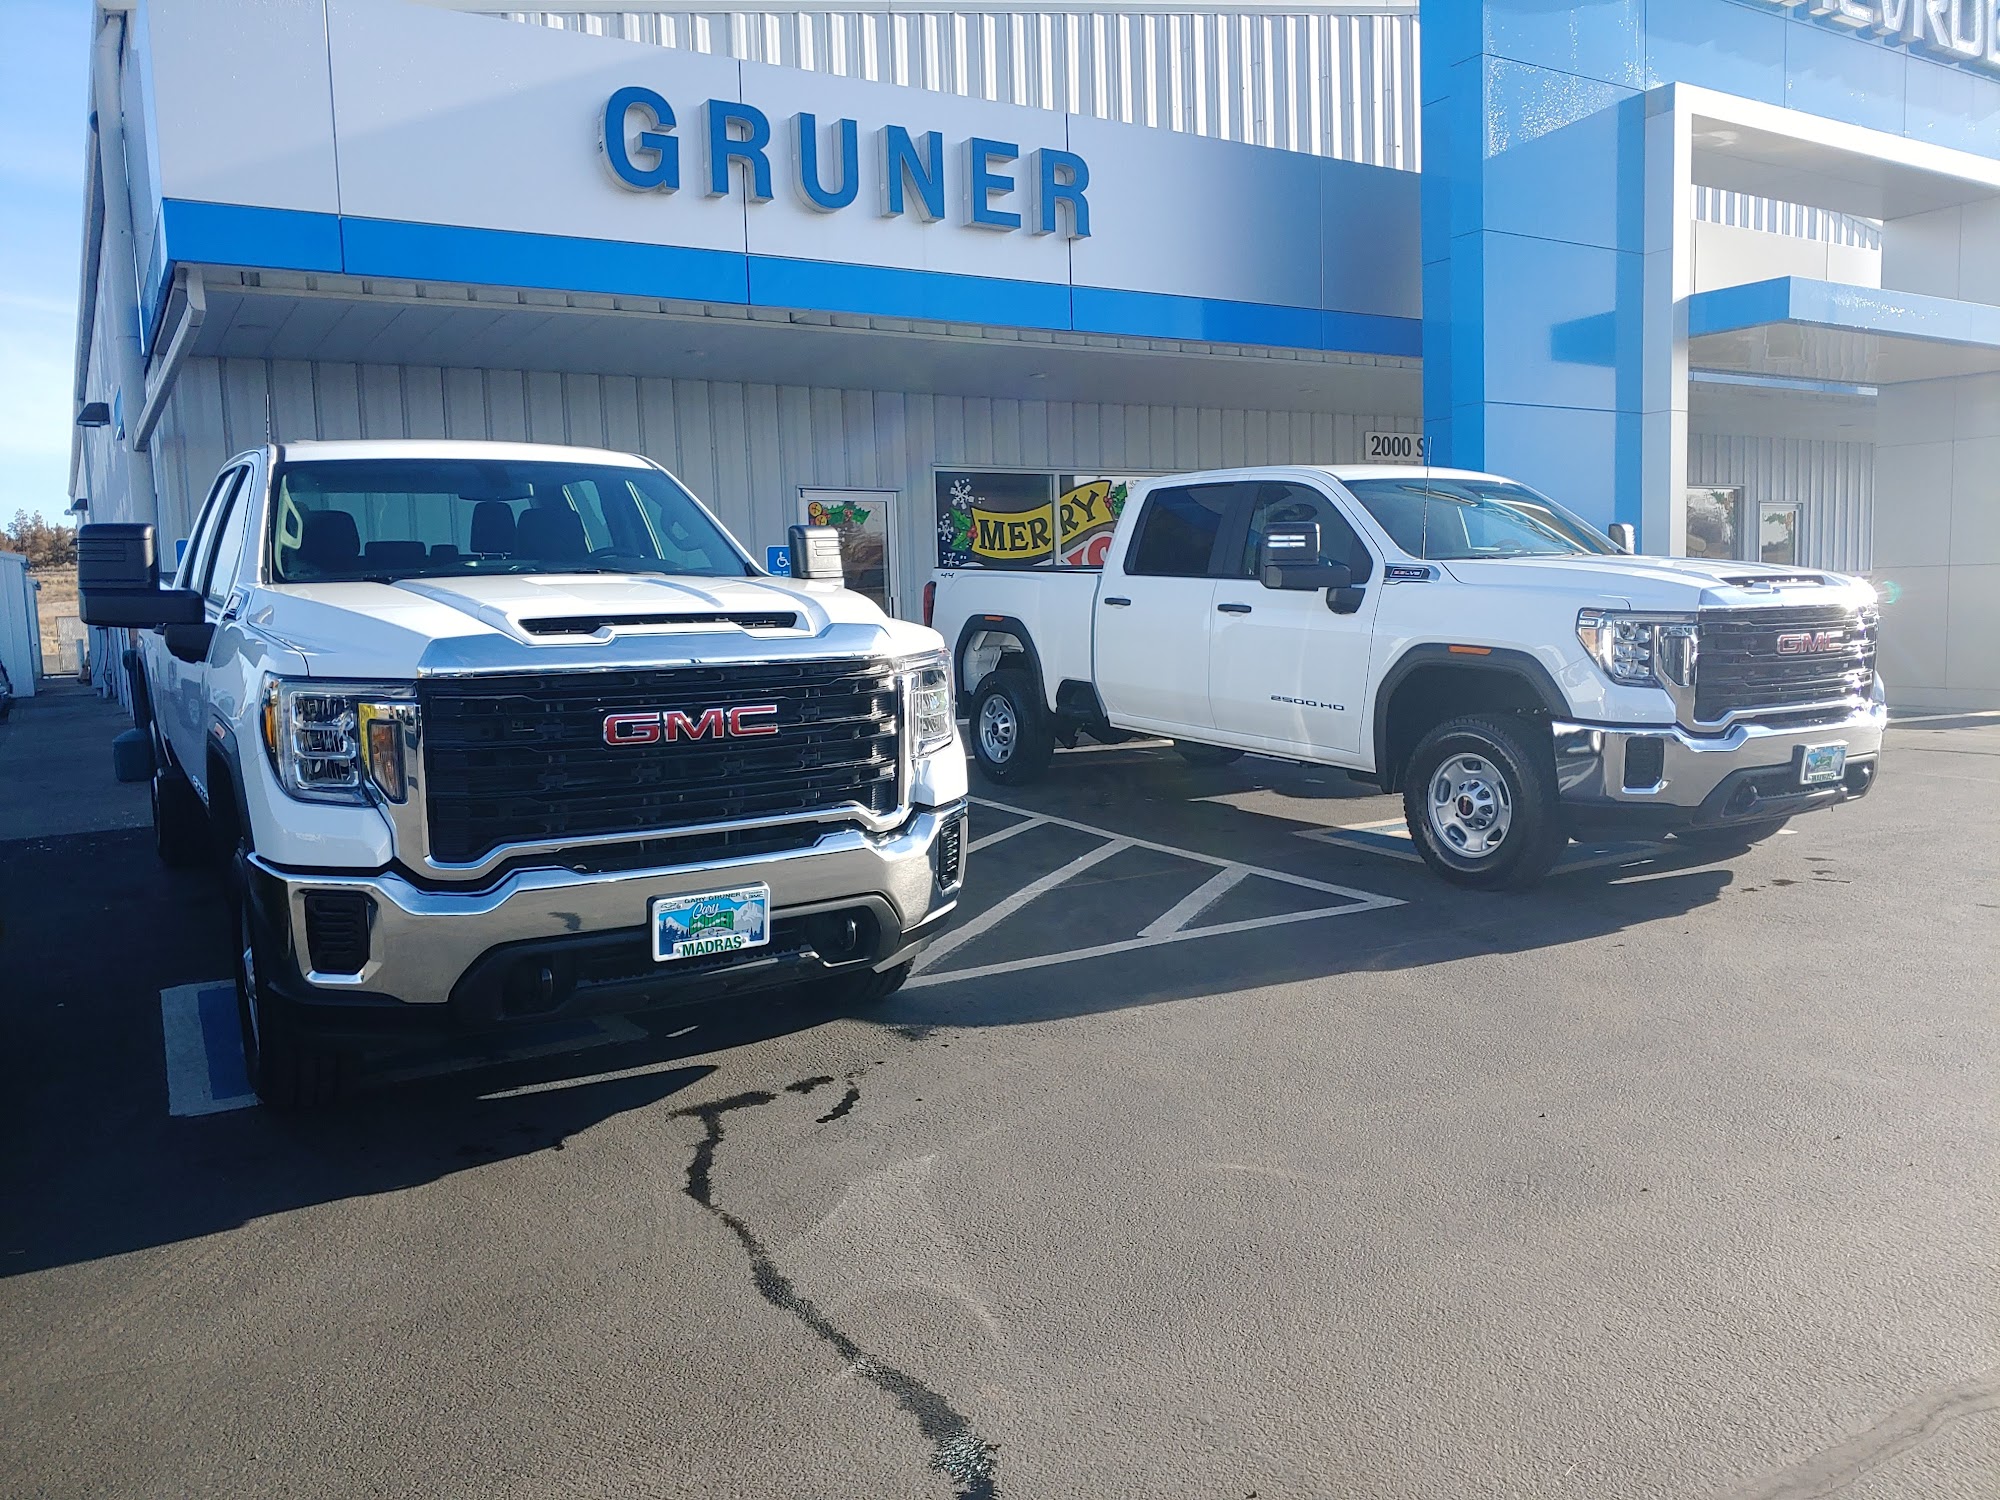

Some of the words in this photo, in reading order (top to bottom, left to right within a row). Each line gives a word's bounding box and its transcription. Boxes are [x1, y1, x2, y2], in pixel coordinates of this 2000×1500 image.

[603, 86, 1092, 240] GRUNER
[1371, 435, 1412, 457] 2000
[978, 489, 1100, 552] MERRY
[1777, 630, 1844, 655] GMC
[1270, 695, 1317, 707] 2500
[1320, 702, 1345, 711] HD
[603, 704, 779, 746] GMC
[684, 896, 707, 904] GARY
[708, 892, 741, 901] GRUNER
[692, 903, 719, 920] Gary
[682, 935, 742, 957] MADRAS
